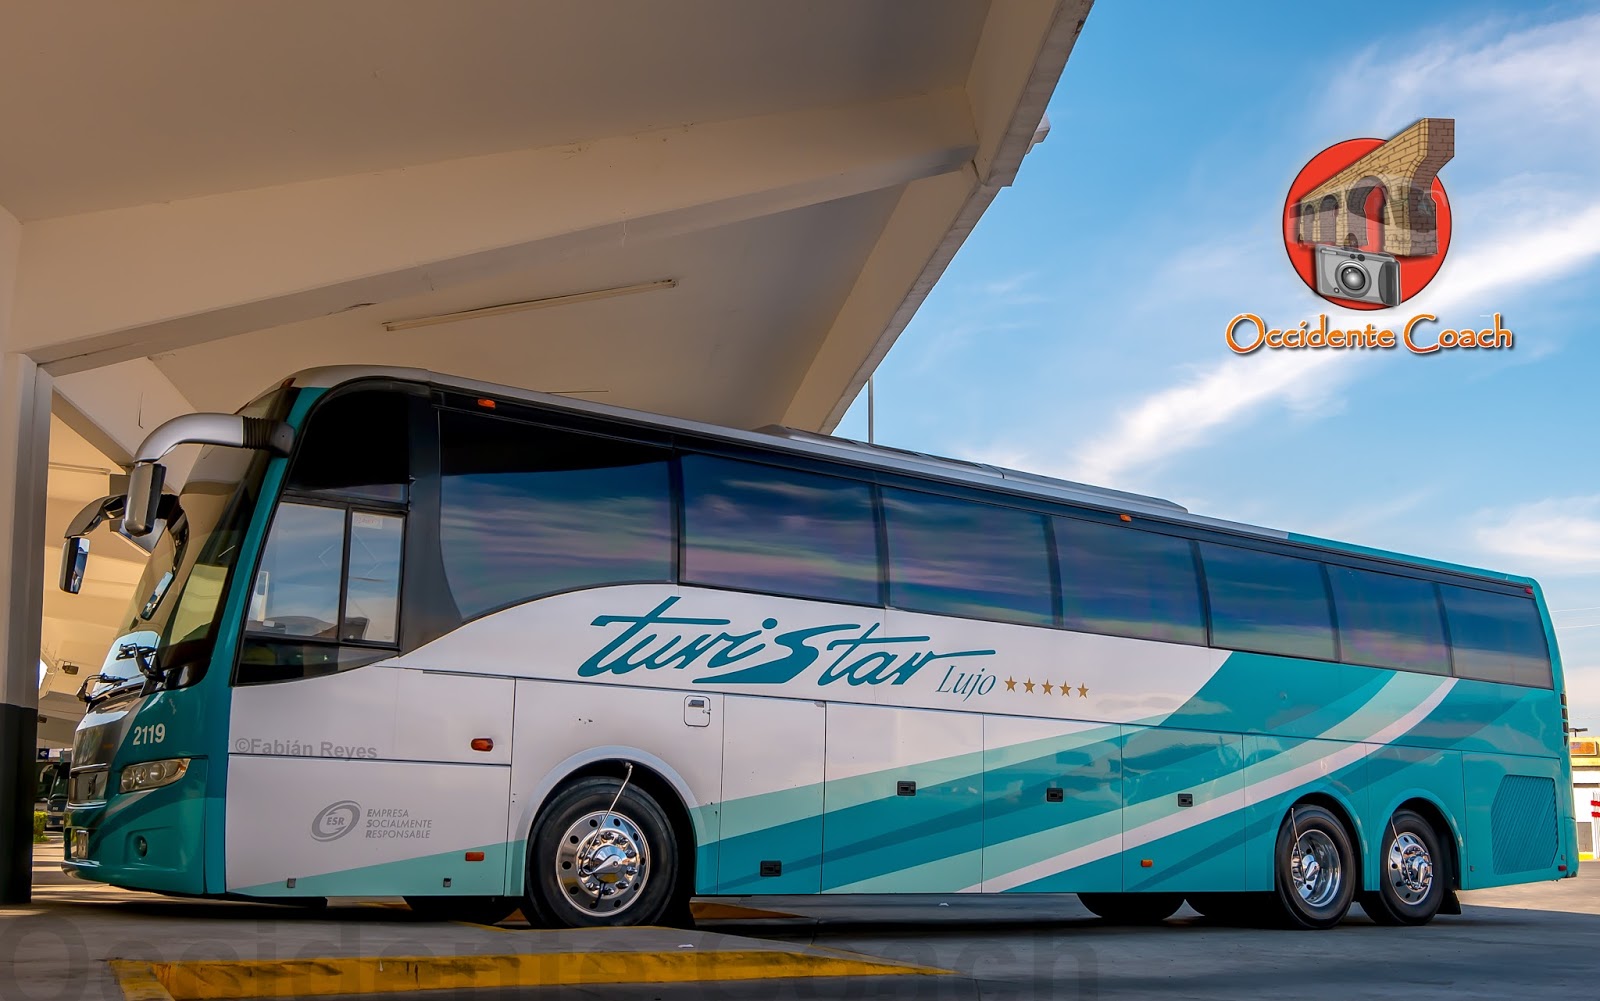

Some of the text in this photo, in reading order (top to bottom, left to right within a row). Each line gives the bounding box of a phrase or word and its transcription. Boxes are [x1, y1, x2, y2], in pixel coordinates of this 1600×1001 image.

[935, 664, 996, 703] Lujo
[132, 722, 166, 746] 2119
[366, 808, 410, 818] EMPRESA
[326, 816, 346, 826] ESR
[365, 819, 433, 829] SOCIALMENTE
[365, 829, 431, 839] RESPONSABLE
